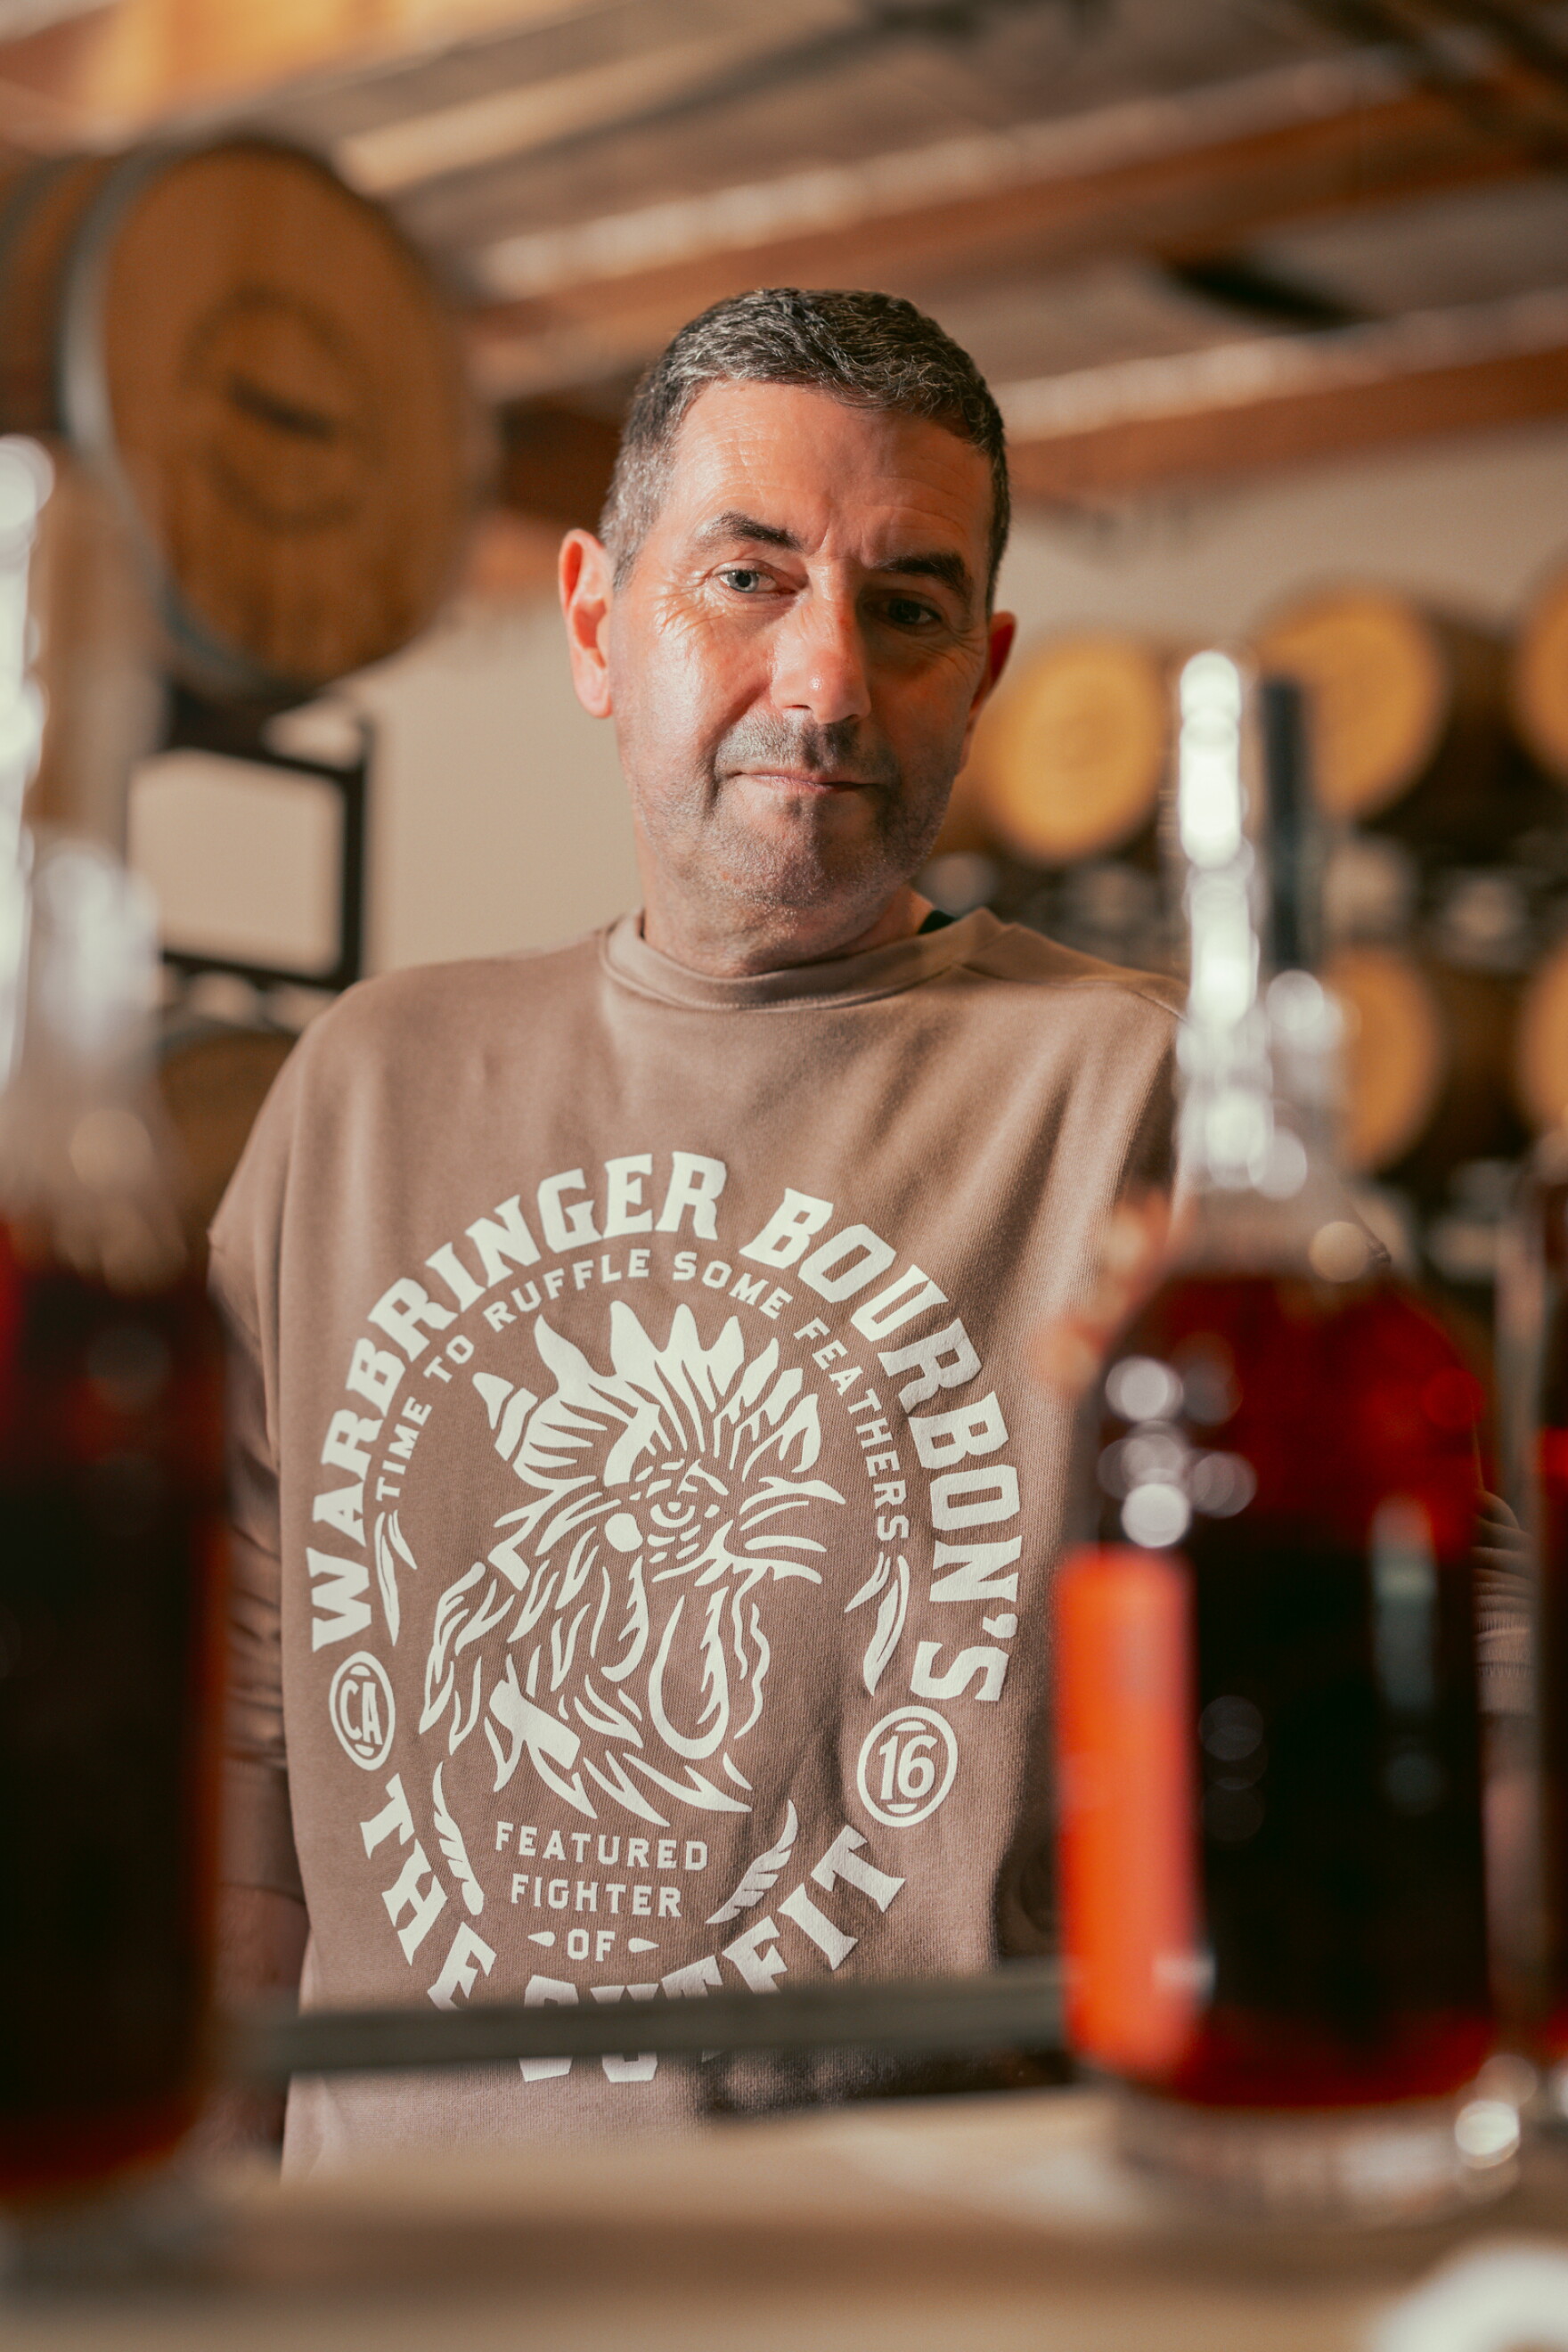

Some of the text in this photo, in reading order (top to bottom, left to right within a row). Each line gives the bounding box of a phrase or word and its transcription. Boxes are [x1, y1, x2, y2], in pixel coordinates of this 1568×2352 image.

[306, 1150, 728, 1652] WARBRINGER
[375, 1249, 911, 1544] TIME TO RUFFLE SOME FEATHERS
[339, 1680, 383, 1748] CA
[878, 1734, 937, 1801] 16
[494, 1821, 709, 1871] FEATURED
[360, 1773, 497, 2010] THE
[510, 1874, 682, 1917] FIGHTER
[567, 1928, 617, 1962] OF
